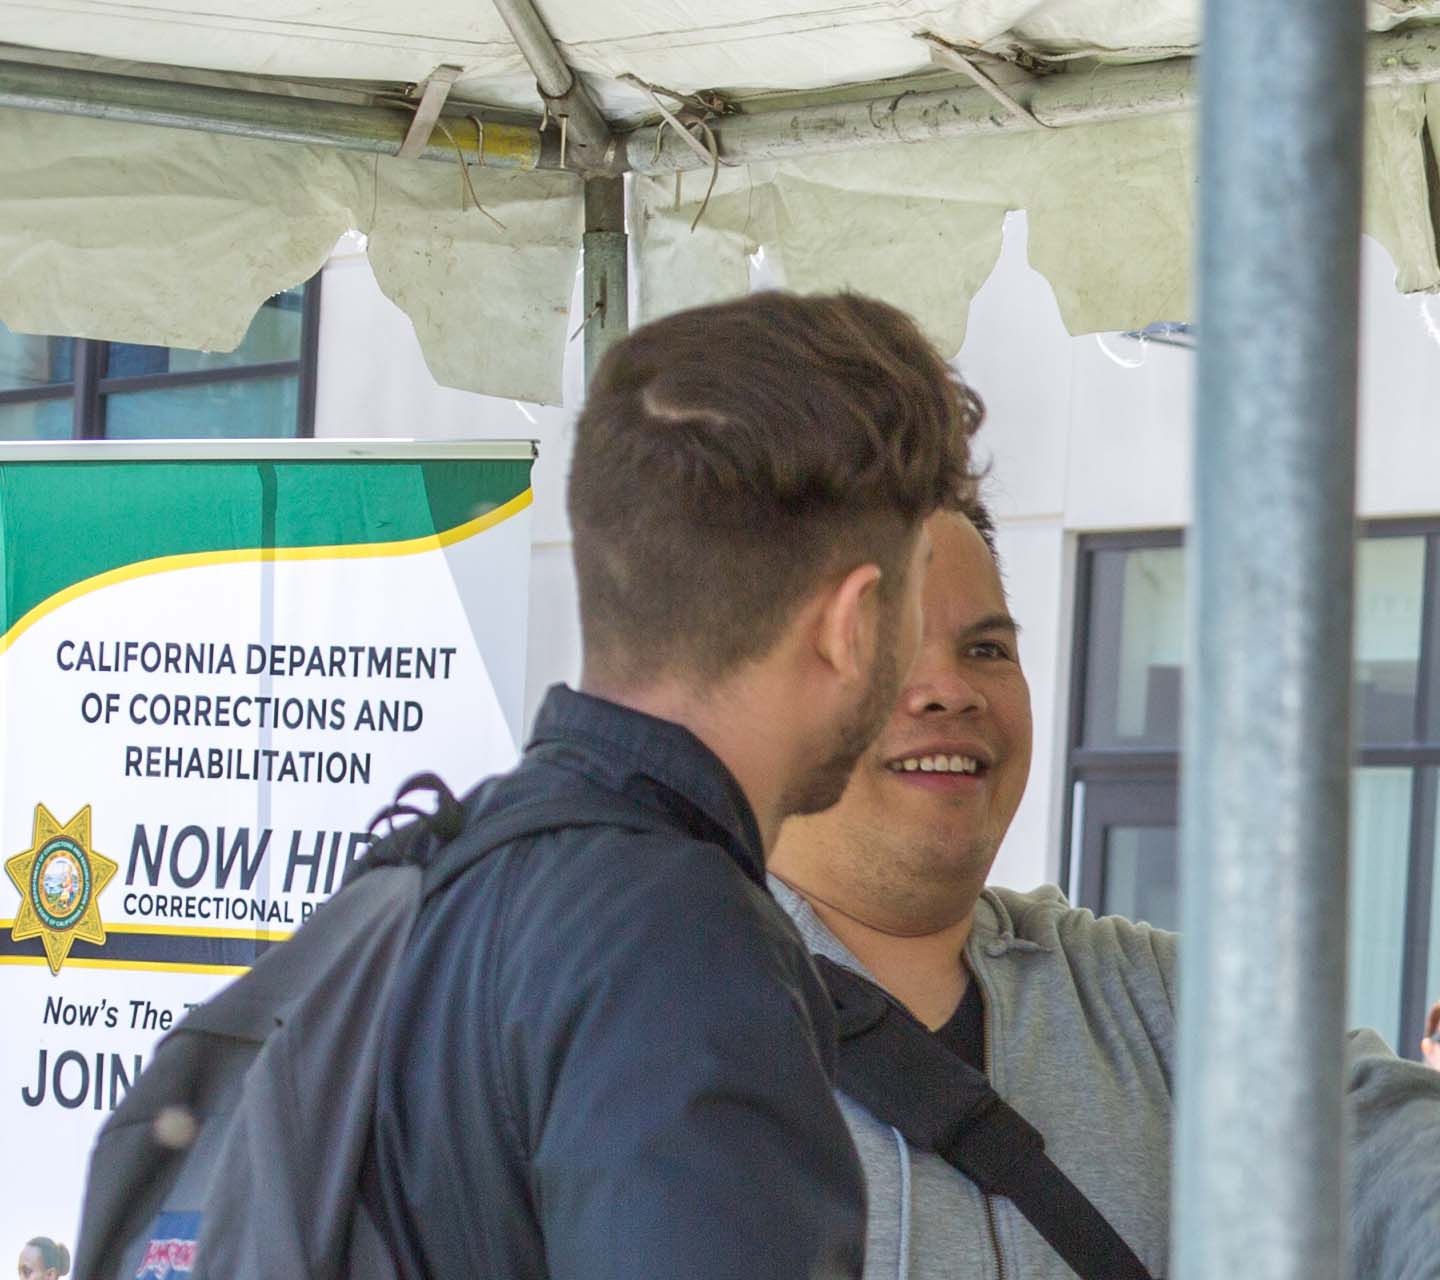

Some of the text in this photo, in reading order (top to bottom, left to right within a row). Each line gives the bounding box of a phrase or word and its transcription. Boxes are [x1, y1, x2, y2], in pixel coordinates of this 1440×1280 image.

[56, 640, 457, 680] CALIFORNIA DEPARTMENT
[81, 693, 424, 733] OF CORRECTIONS AND
[124, 746, 372, 785] REHABILITATION
[125, 824, 272, 890] NOW
[123, 893, 294, 923] CORRECTIONAL
[42, 995, 119, 1030] Now's
[129, 1000, 173, 1031] The
